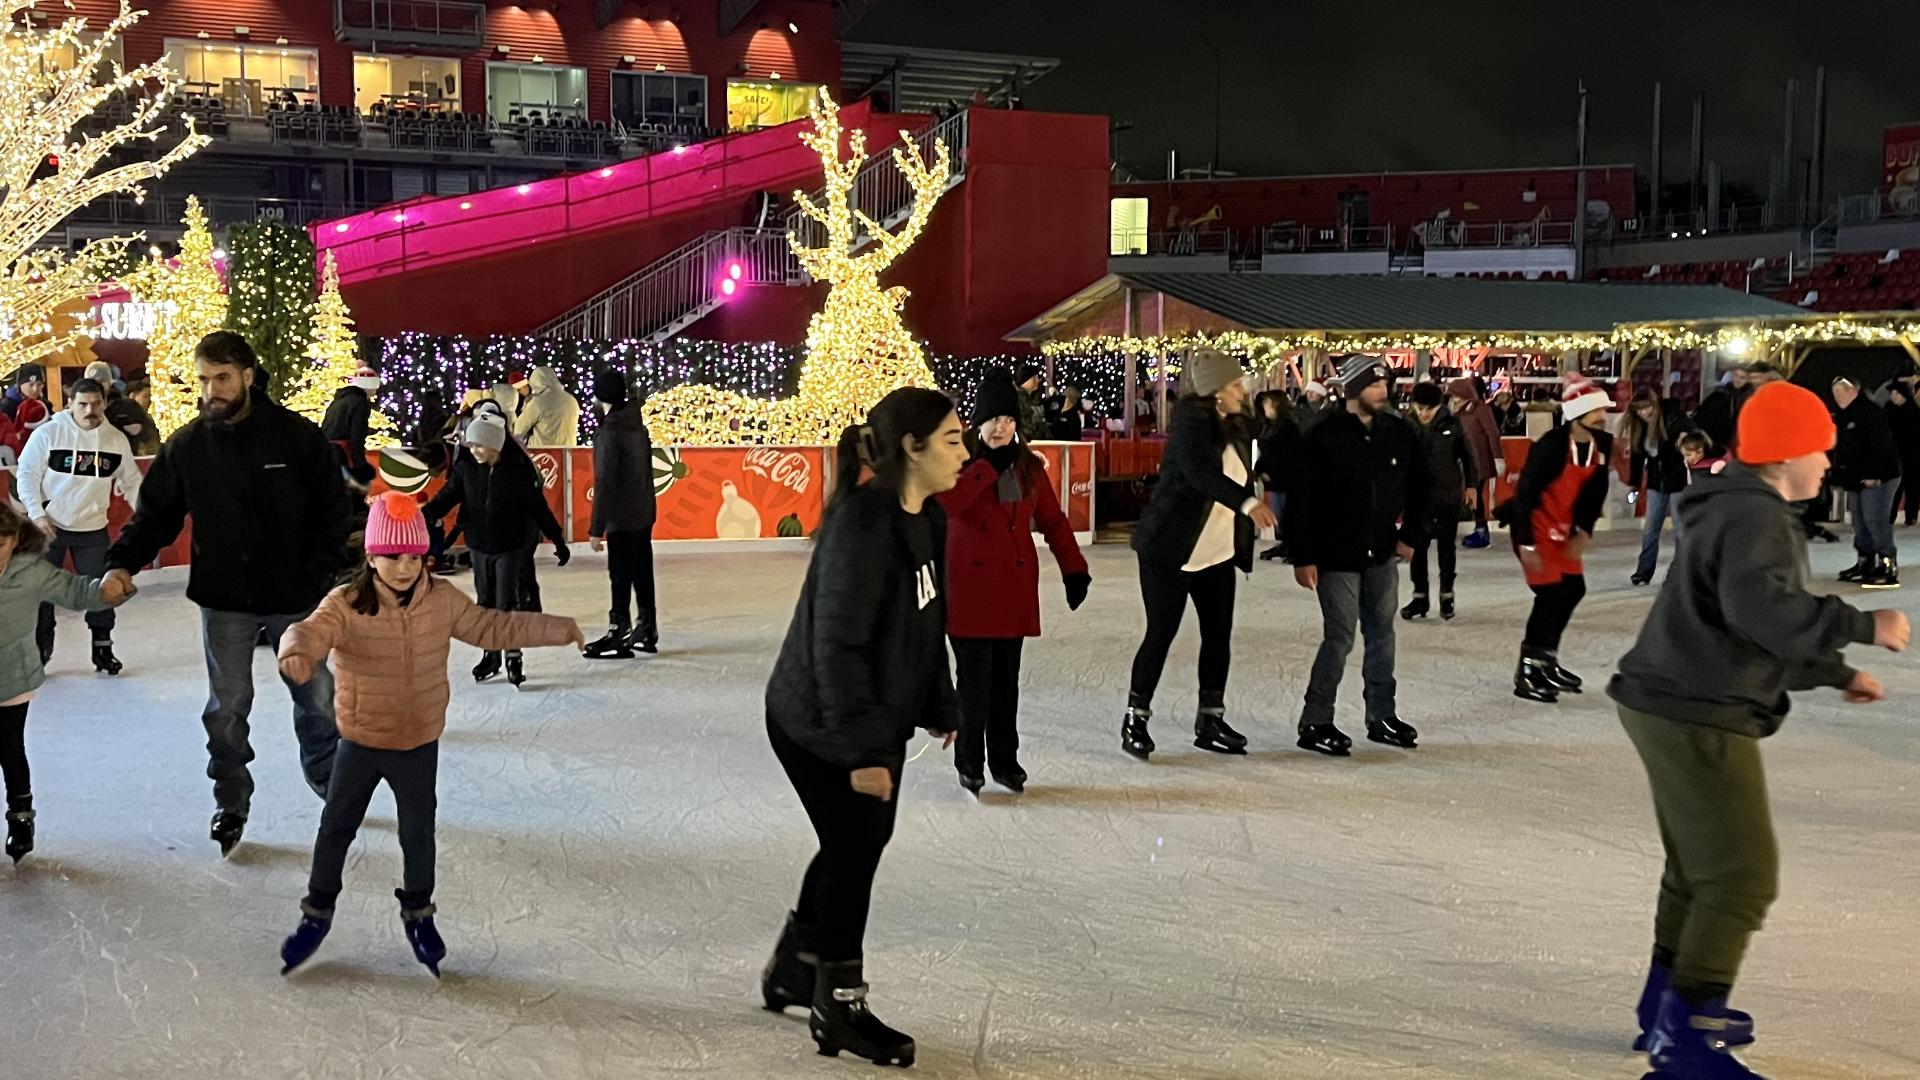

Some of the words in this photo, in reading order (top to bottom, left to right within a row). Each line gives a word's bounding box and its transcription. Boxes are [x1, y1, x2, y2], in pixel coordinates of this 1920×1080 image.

[259, 206, 284, 218] 108
[1623, 218, 1637, 231] 112
[1319, 229, 1334, 240] 111
